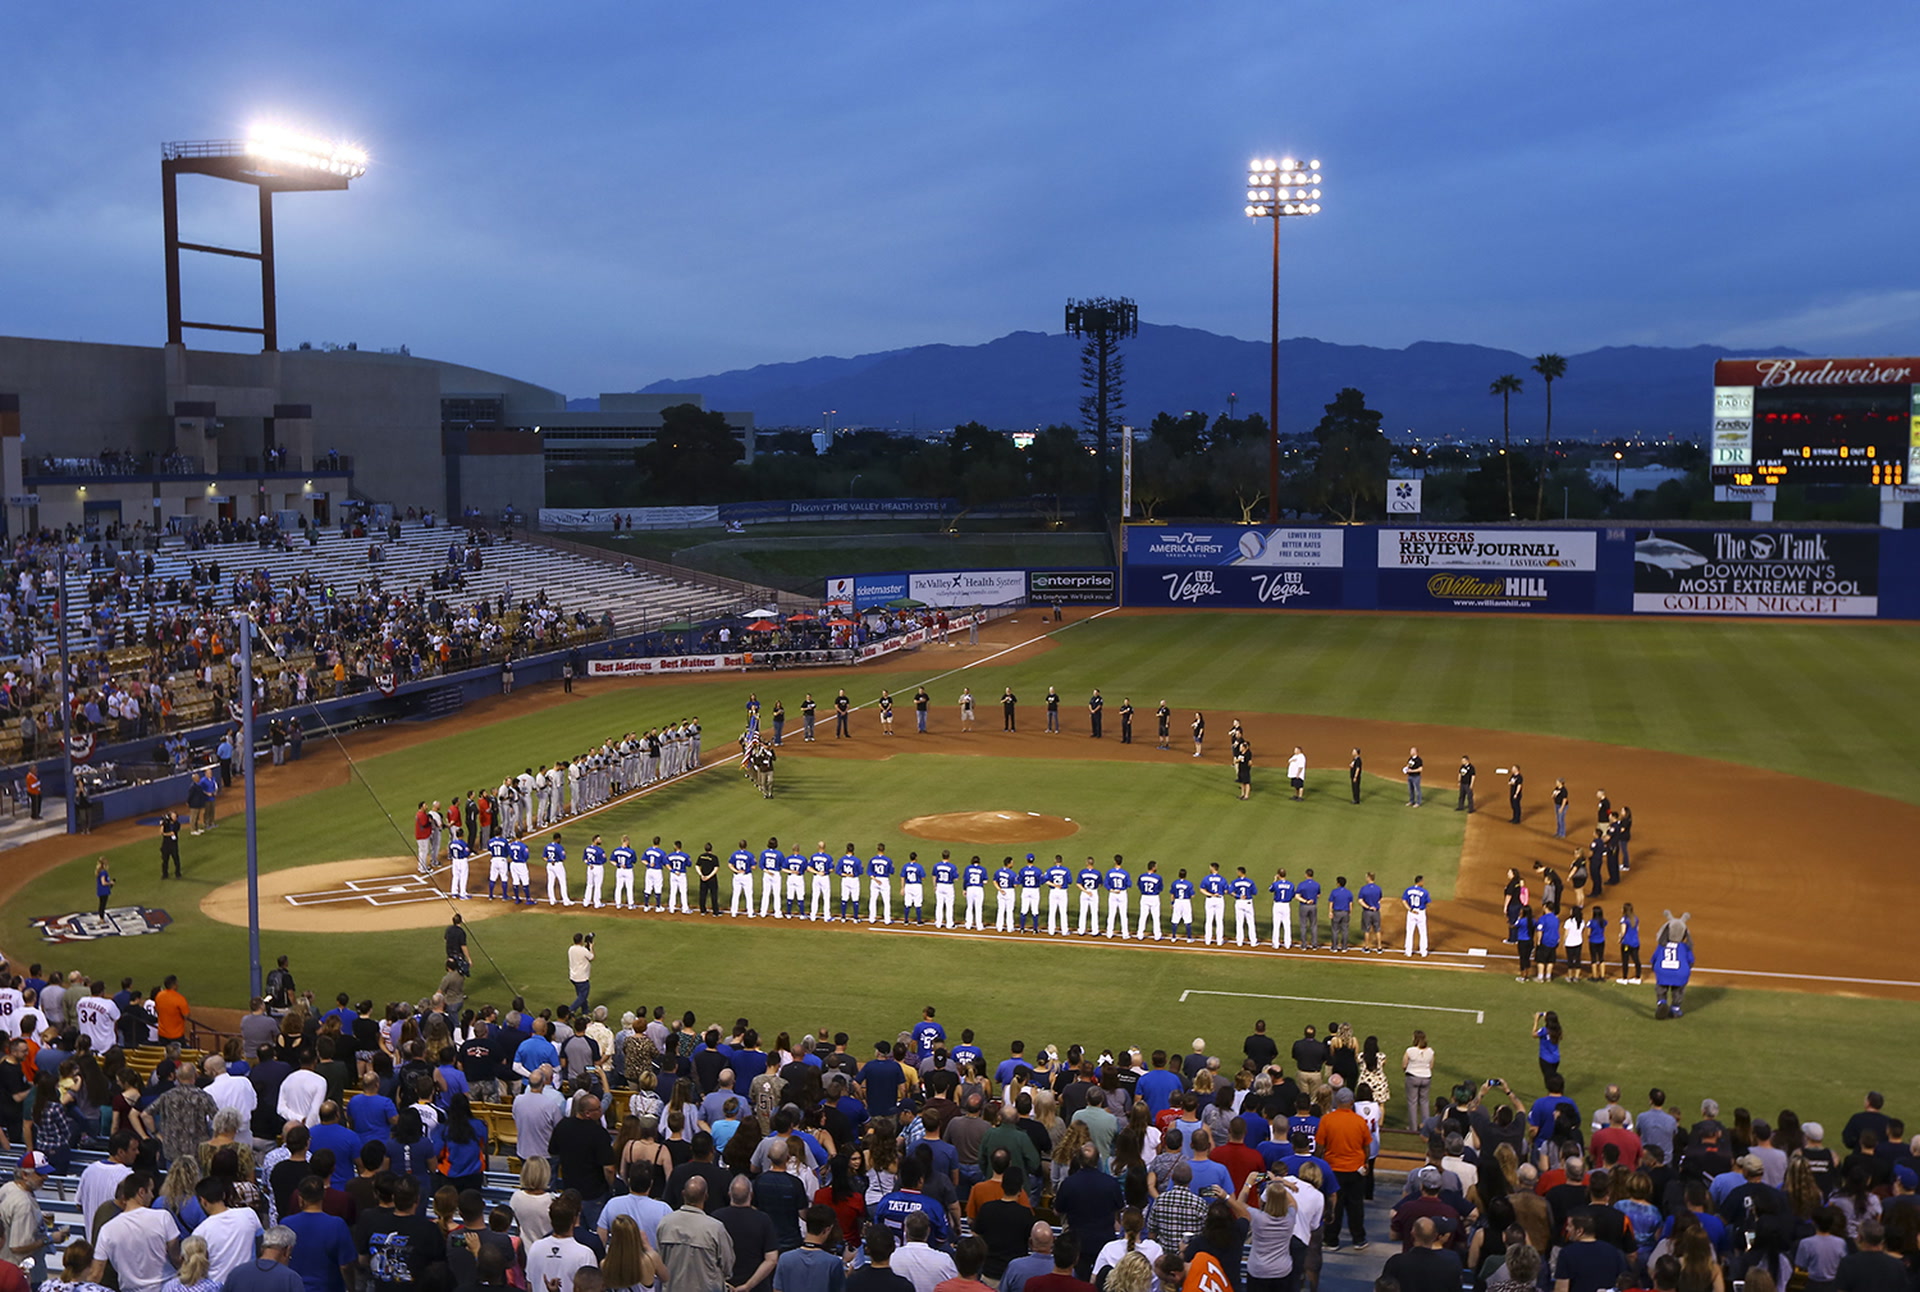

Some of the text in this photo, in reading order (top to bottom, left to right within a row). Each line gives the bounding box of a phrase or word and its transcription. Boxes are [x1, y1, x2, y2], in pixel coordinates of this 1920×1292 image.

[1756, 359, 1911, 387] Budweiser
[1720, 448, 1744, 462] DR
[1392, 501, 1415, 511] CSN
[1400, 532, 1475, 543] LAS VEGAS
[1150, 545, 1222, 553] AMERICA FIRST
[1400, 543, 1559, 557] REVIEW-JOURNAL
[1714, 533, 1827, 560] The Tank
[1400, 555, 1430, 567] LVRJ
[1510, 559, 1523, 567] LAS
[1524, 559, 1546, 567] VEGAS
[1561, 560, 1576, 568] SUN
[1704, 565, 1835, 579] DOWNTOWN'S
[915, 577, 1021, 589] The Valley Health System
[1033, 576, 1111, 587] enterprise
[1163, 573, 1221, 602] Vegas
[1427, 573, 1547, 597] William HILL
[1679, 579, 1860, 595] MOST EXTREME POOL
[857, 585, 902, 596] ticketmaster
[1252, 574, 1310, 604] Vegas
[1664, 596, 1838, 613] GOLDEN NUGGET
[595, 656, 741, 672] Best Mattress Best Mattress Best
[1664, 948, 1677, 961] 51
[80, 1010, 97, 1024] 34
[760, 1094, 773, 1110] 51
[888, 1200, 922, 1212] TAYLOR
